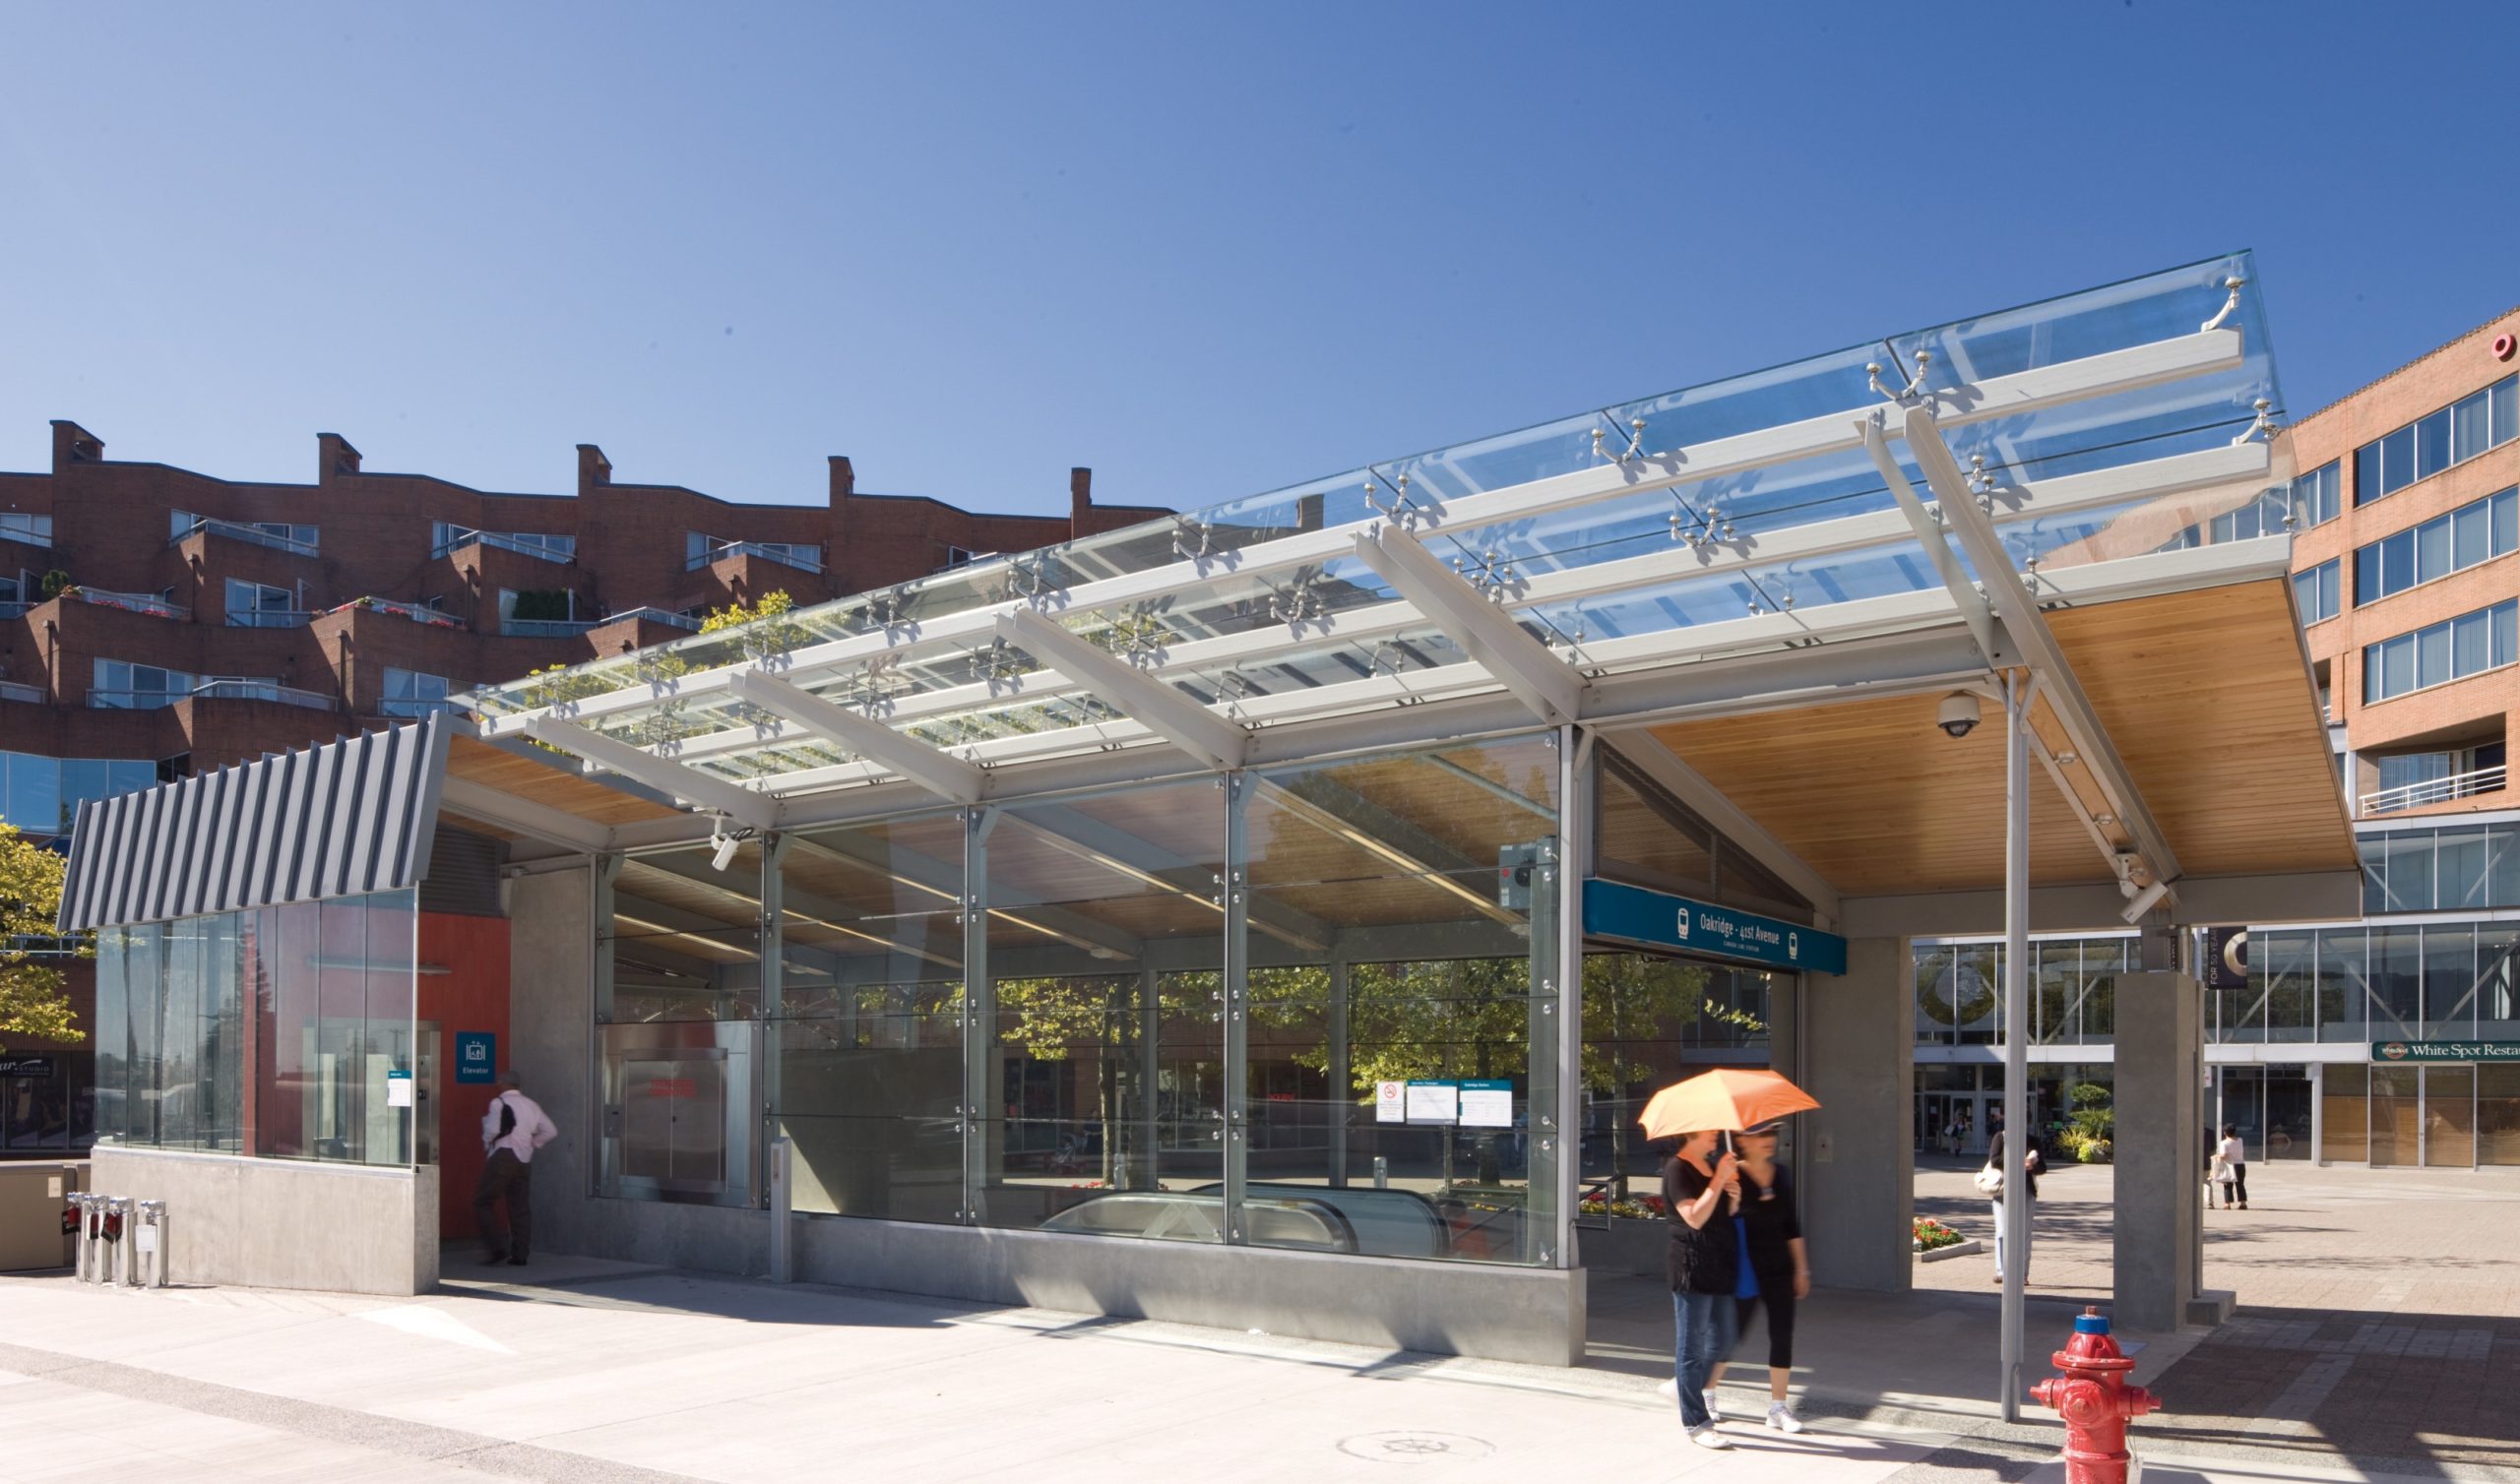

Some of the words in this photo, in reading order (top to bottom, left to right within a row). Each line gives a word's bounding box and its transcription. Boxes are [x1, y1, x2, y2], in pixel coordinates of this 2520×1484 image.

[1700, 913, 1733, 938] Oakridge
[1739, 925, 1754, 941] 41st
[1755, 926, 1780, 945] Avenue
[2210, 954, 2218, 964] 50
[2412, 1044, 2449, 1055] White
[2450, 1044, 2481, 1058] Spot
